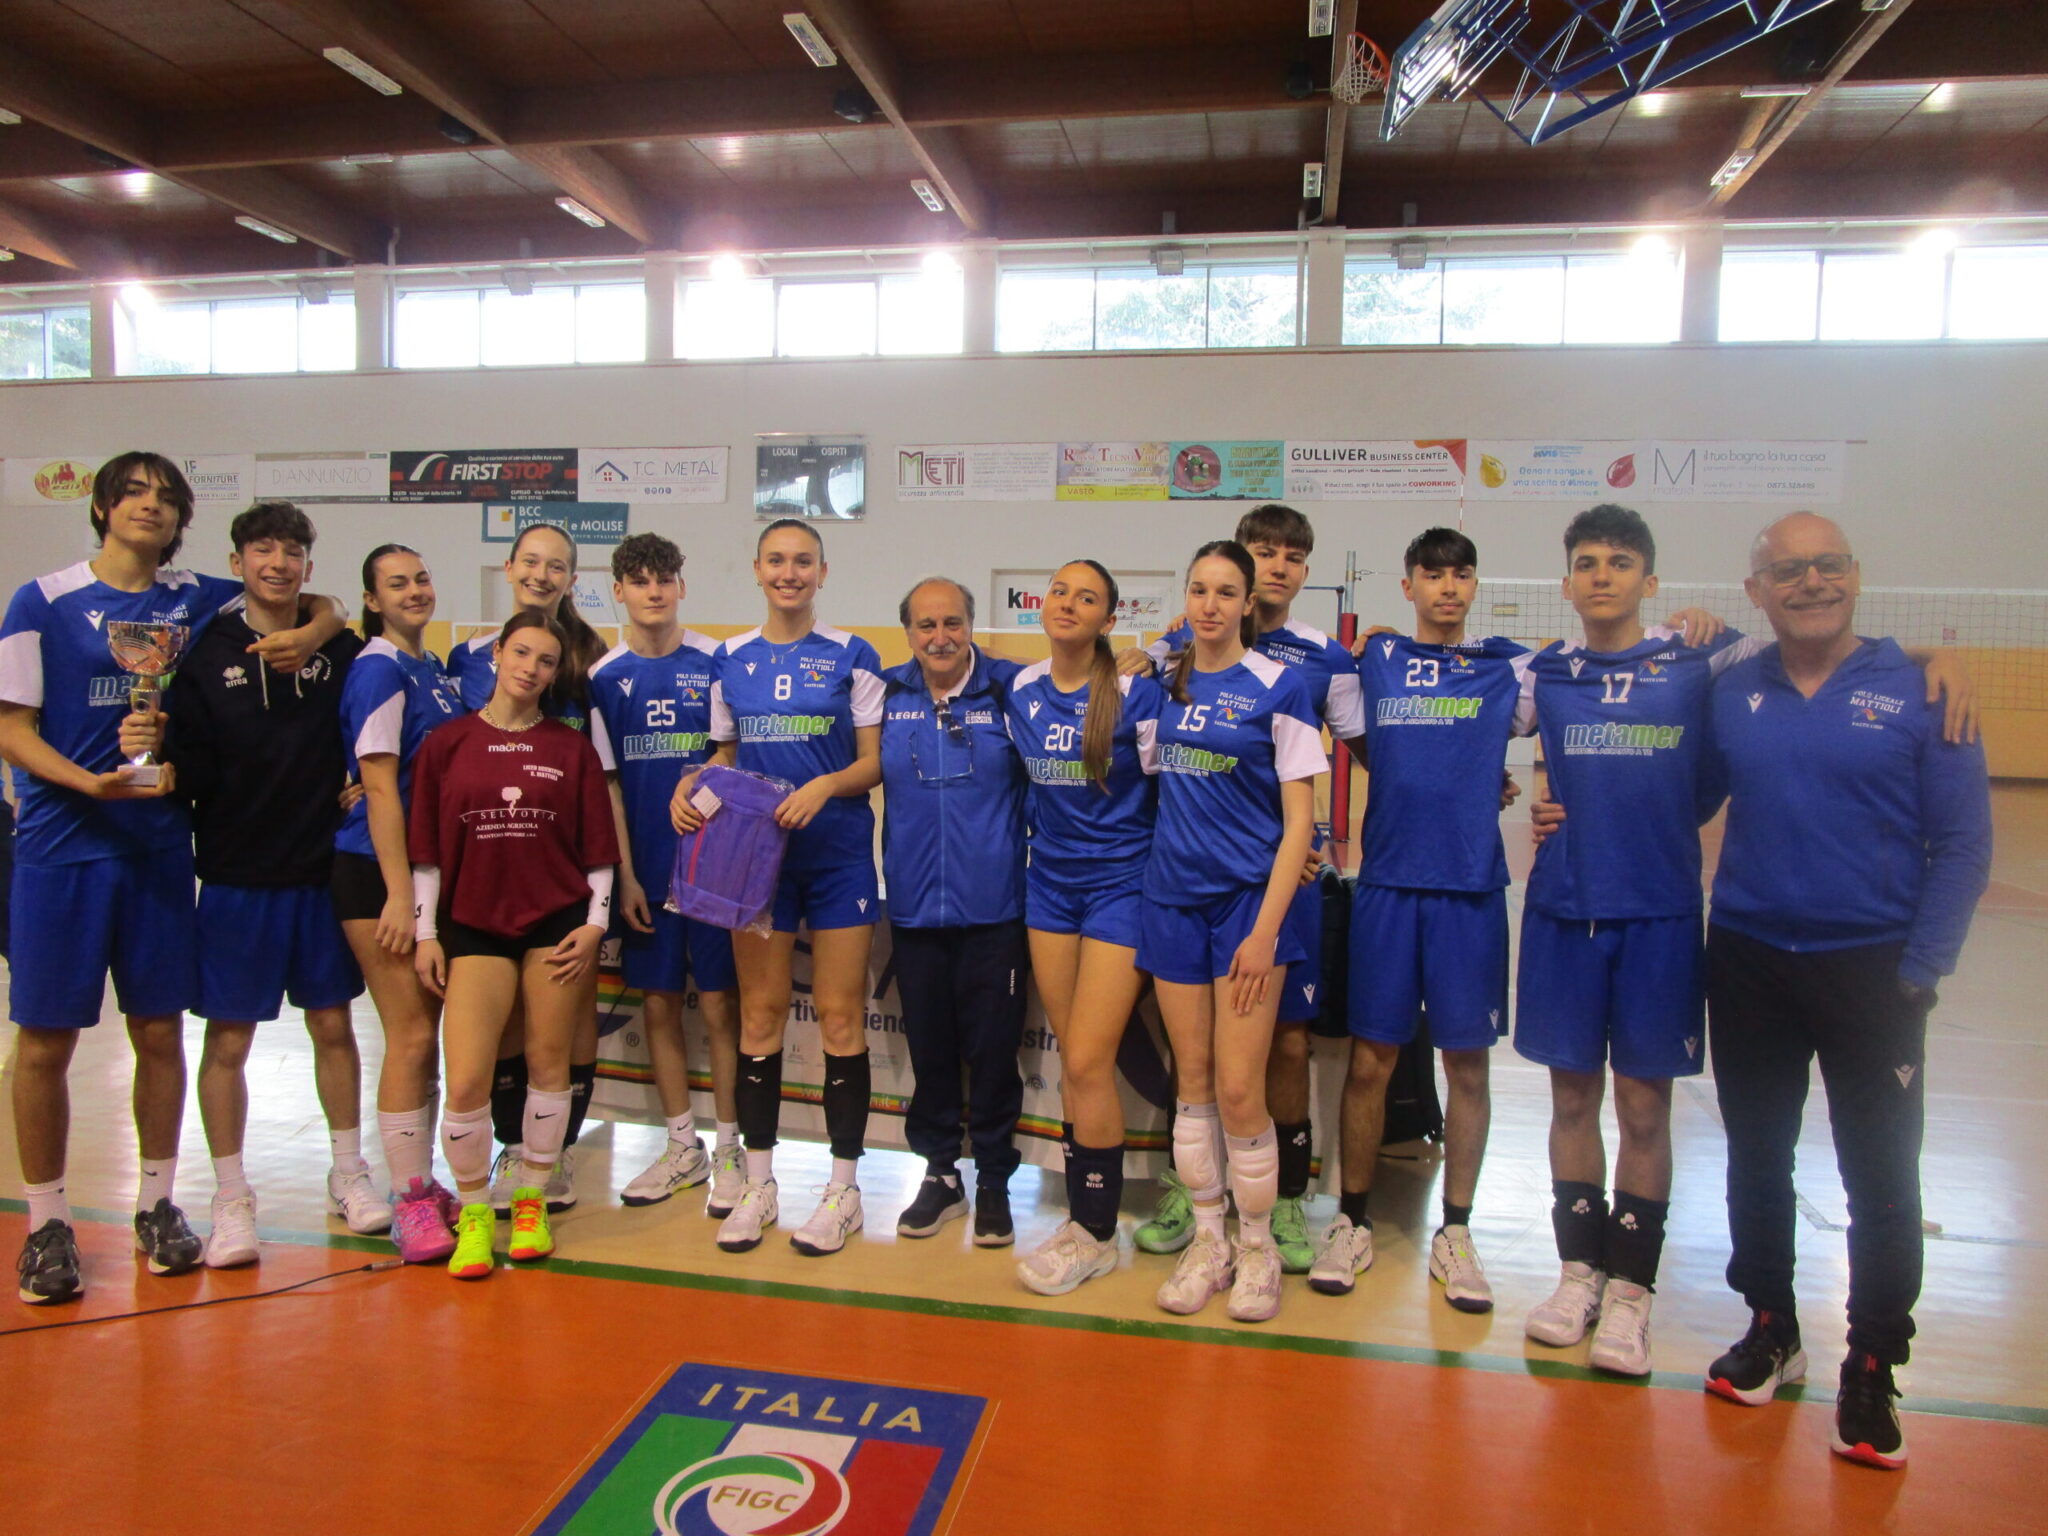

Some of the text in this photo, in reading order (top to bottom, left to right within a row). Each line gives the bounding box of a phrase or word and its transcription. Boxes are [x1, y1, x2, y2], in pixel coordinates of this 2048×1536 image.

[772, 447, 847, 456] LOCALI OSPITI
[1291, 448, 1448, 461] GULLIVER BUSINESS CENTER
[1729, 450, 1765, 464] bagno
[1799, 454, 1826, 462] casa
[664, 460, 720, 476] METAL
[899, 451, 964, 485] METI
[1554, 467, 1585, 477] sangue
[1653, 448, 1695, 485] M
[189, 475, 239, 484] FORNITURE
[519, 506, 541, 516] BCC
[571, 523, 577, 531] e
[581, 520, 624, 531] MOLISE
[1267, 648, 1305, 664] MATTIOLI
[800, 663, 835, 671] MATTIOLI
[1405, 658, 1439, 687] 23
[774, 674, 792, 700] 8
[1601, 673, 1634, 703] 17
[432, 689, 452, 713] 6
[1216, 698, 1254, 711] MATTIOLI
[1219, 691, 1257, 704] POLO LICEALE
[1850, 696, 1901, 714] MATTIOLI
[646, 700, 676, 726] 25
[888, 711, 925, 720] LEGEA
[1377, 695, 1483, 719] metamer
[739, 714, 836, 737] metamer
[1176, 705, 1212, 731] 15
[624, 731, 712, 755] metamer
[1044, 723, 1076, 751] 20
[1564, 722, 1684, 749] metamer
[488, 743, 533, 752] macron
[476, 823, 506, 832] AZIENDA
[698, 1383, 922, 1433] ITALIA
[712, 1485, 799, 1513] FIGC
